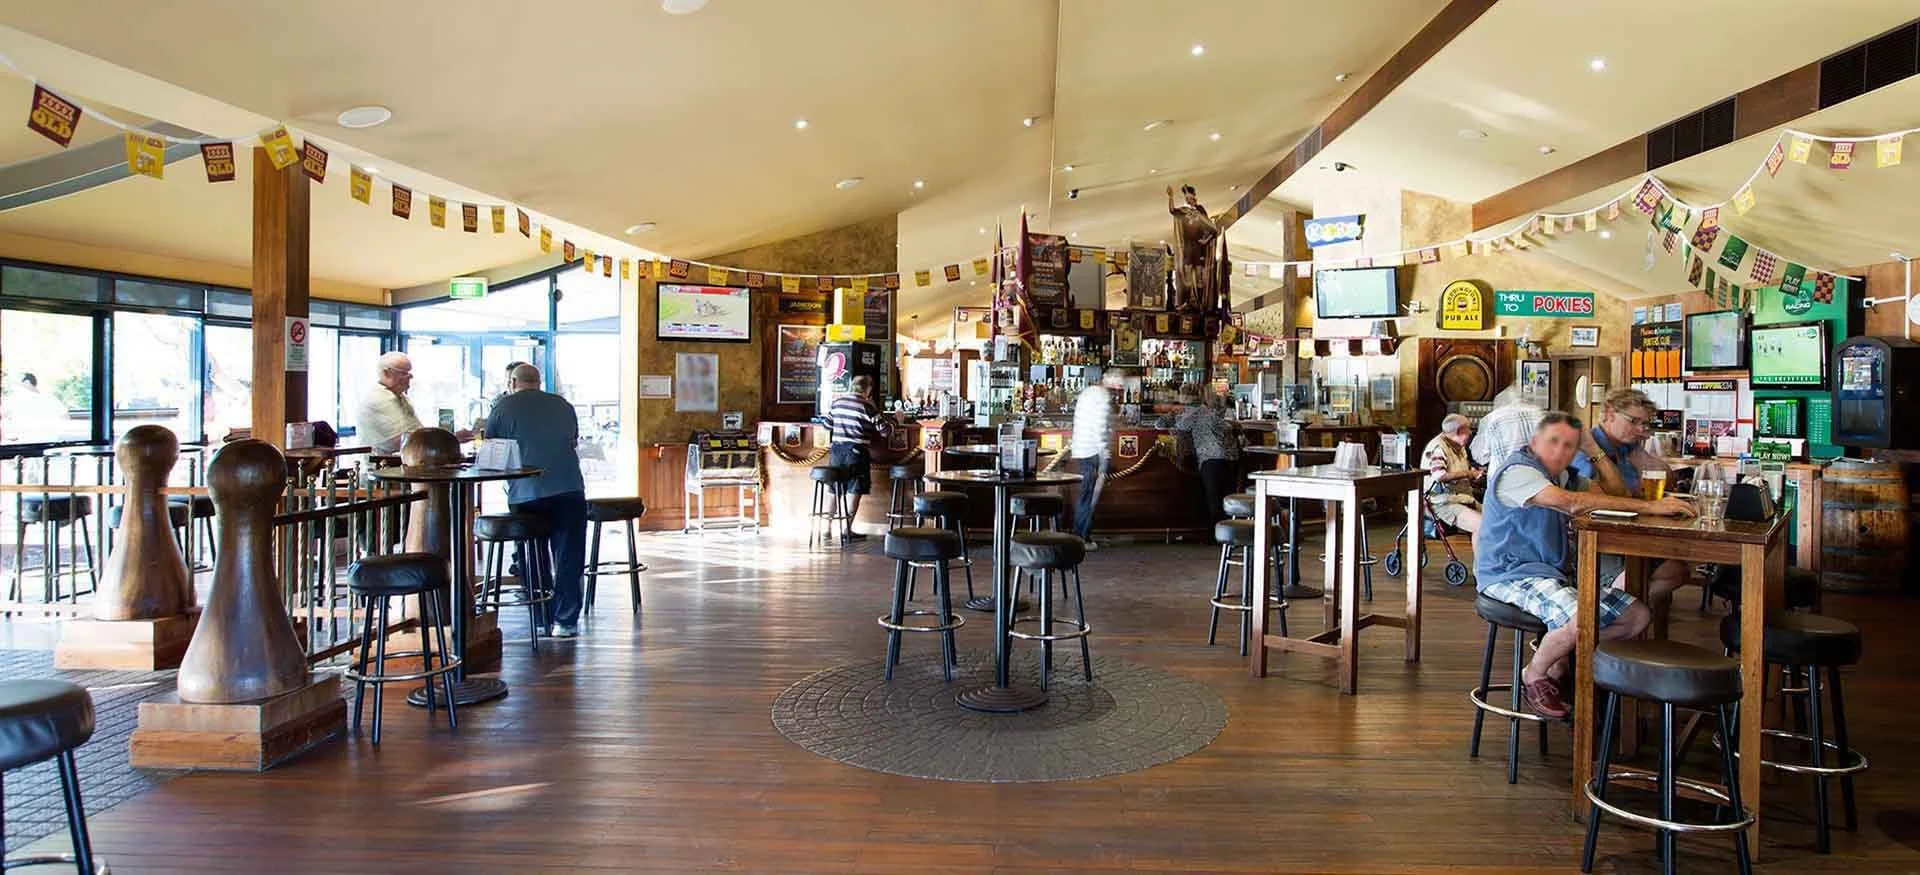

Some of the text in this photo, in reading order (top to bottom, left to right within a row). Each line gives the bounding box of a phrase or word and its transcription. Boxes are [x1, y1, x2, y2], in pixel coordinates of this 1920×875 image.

[32, 107, 73, 138] QLD
[207, 162, 234, 176] QLD
[303, 158, 325, 177] QLD
[1785, 275, 1800, 286] PLAY
[1499, 293, 1592, 313] THRU POKIES
[1503, 303, 1519, 312] TO
